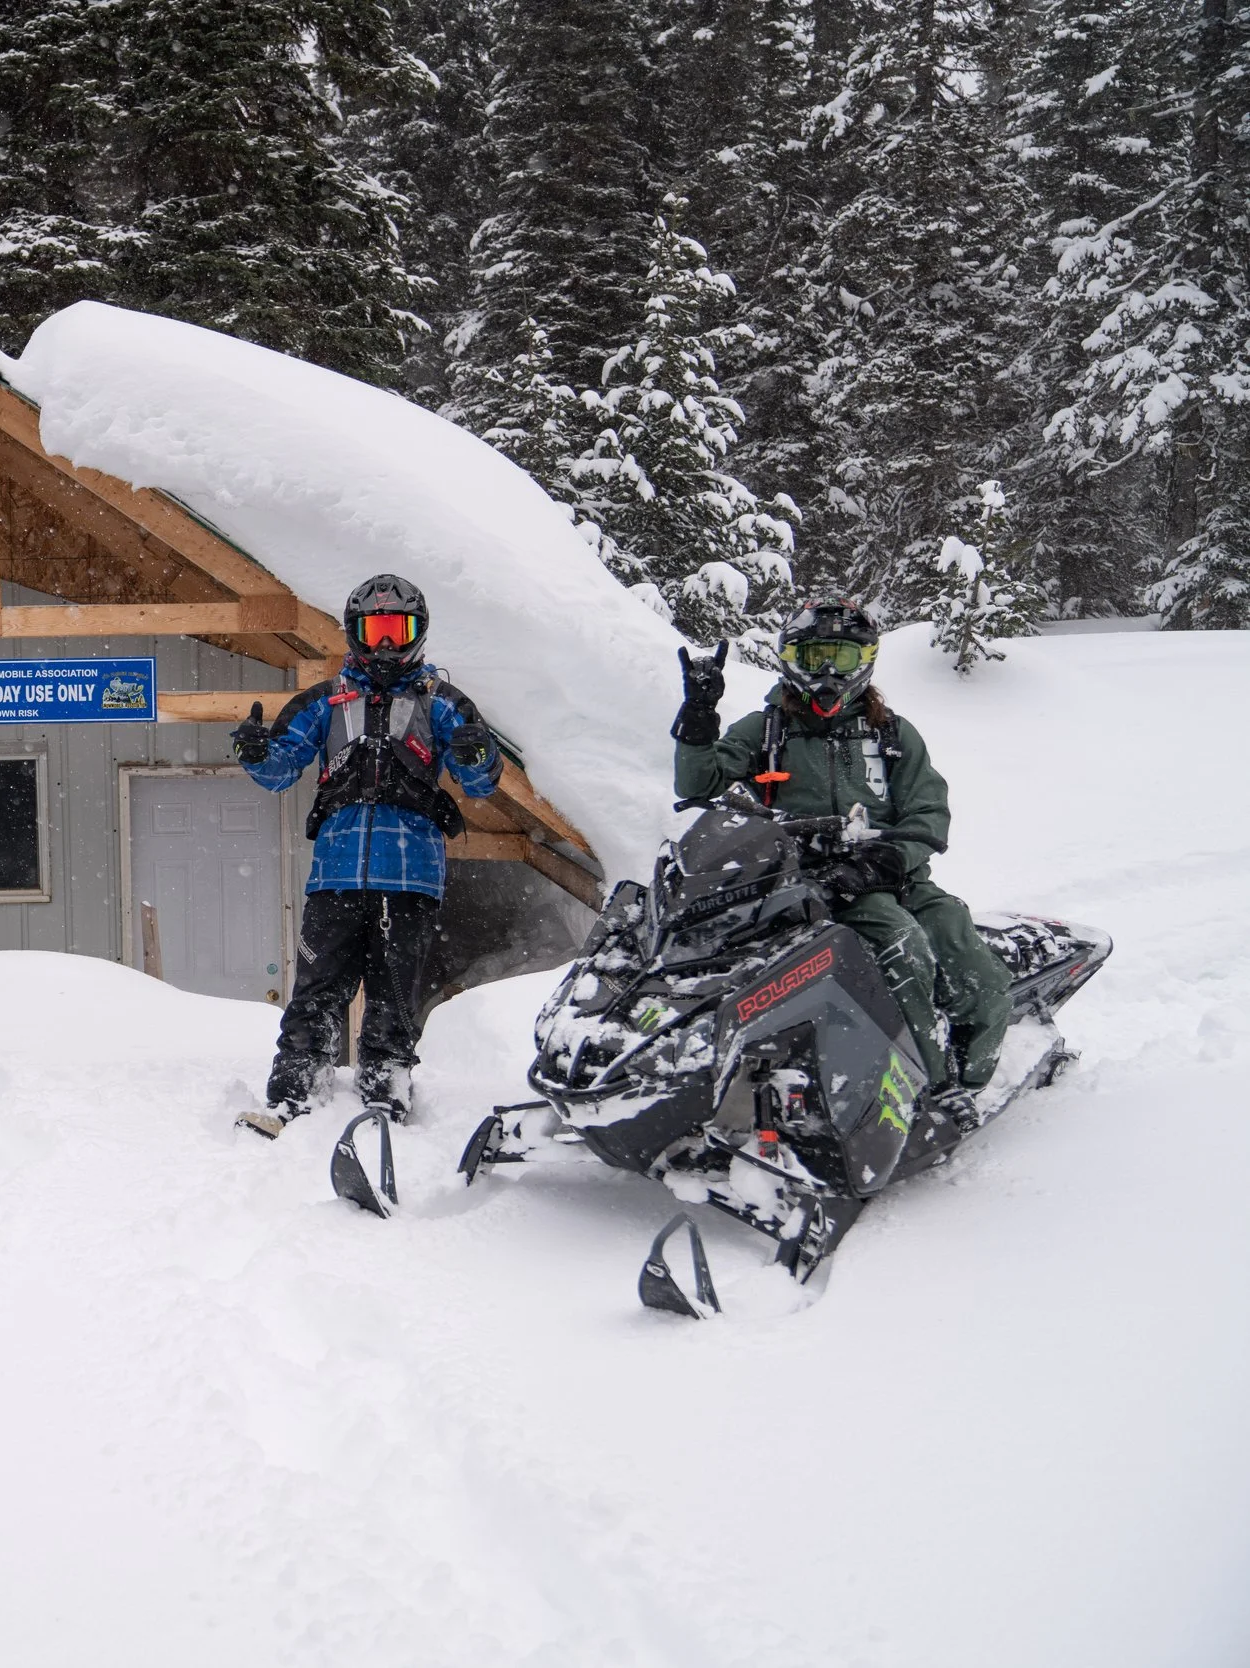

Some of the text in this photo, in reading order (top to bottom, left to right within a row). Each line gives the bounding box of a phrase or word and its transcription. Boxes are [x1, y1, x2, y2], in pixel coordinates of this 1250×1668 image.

[34, 668, 98, 678] ASSOCIATION
[25, 684, 54, 703] USE
[57, 684, 95, 702] ONLY
[18, 709, 39, 717] RISK
[737, 947, 833, 1021] POLARIS
